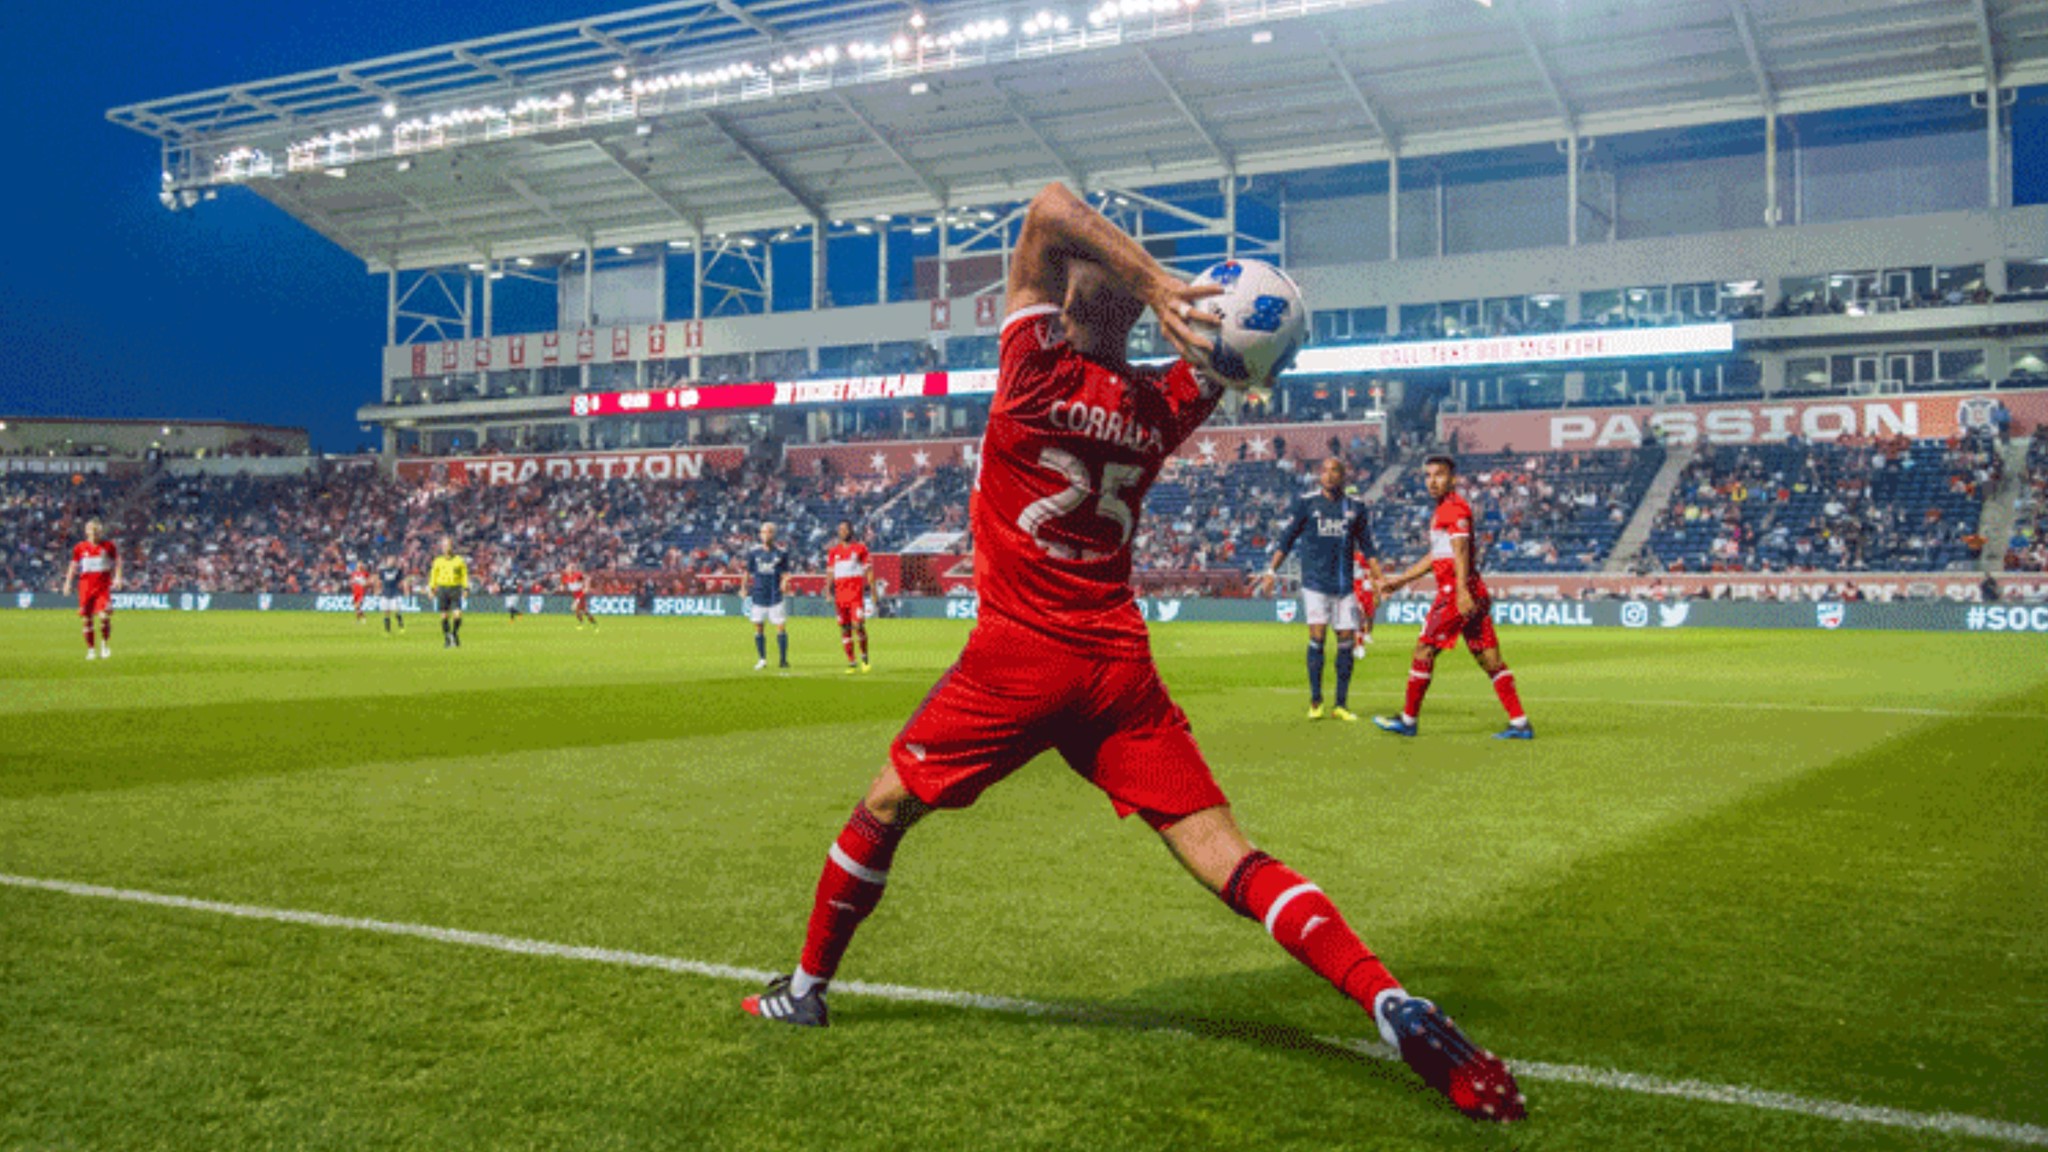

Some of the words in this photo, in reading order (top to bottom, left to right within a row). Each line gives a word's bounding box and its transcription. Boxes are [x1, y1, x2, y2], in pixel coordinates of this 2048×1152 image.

[1550, 401, 1919, 449] PASSION
[464, 453, 704, 486] TRADITION
[1016, 446, 1145, 561] 25
[1967, 606, 2048, 631] #SOC
